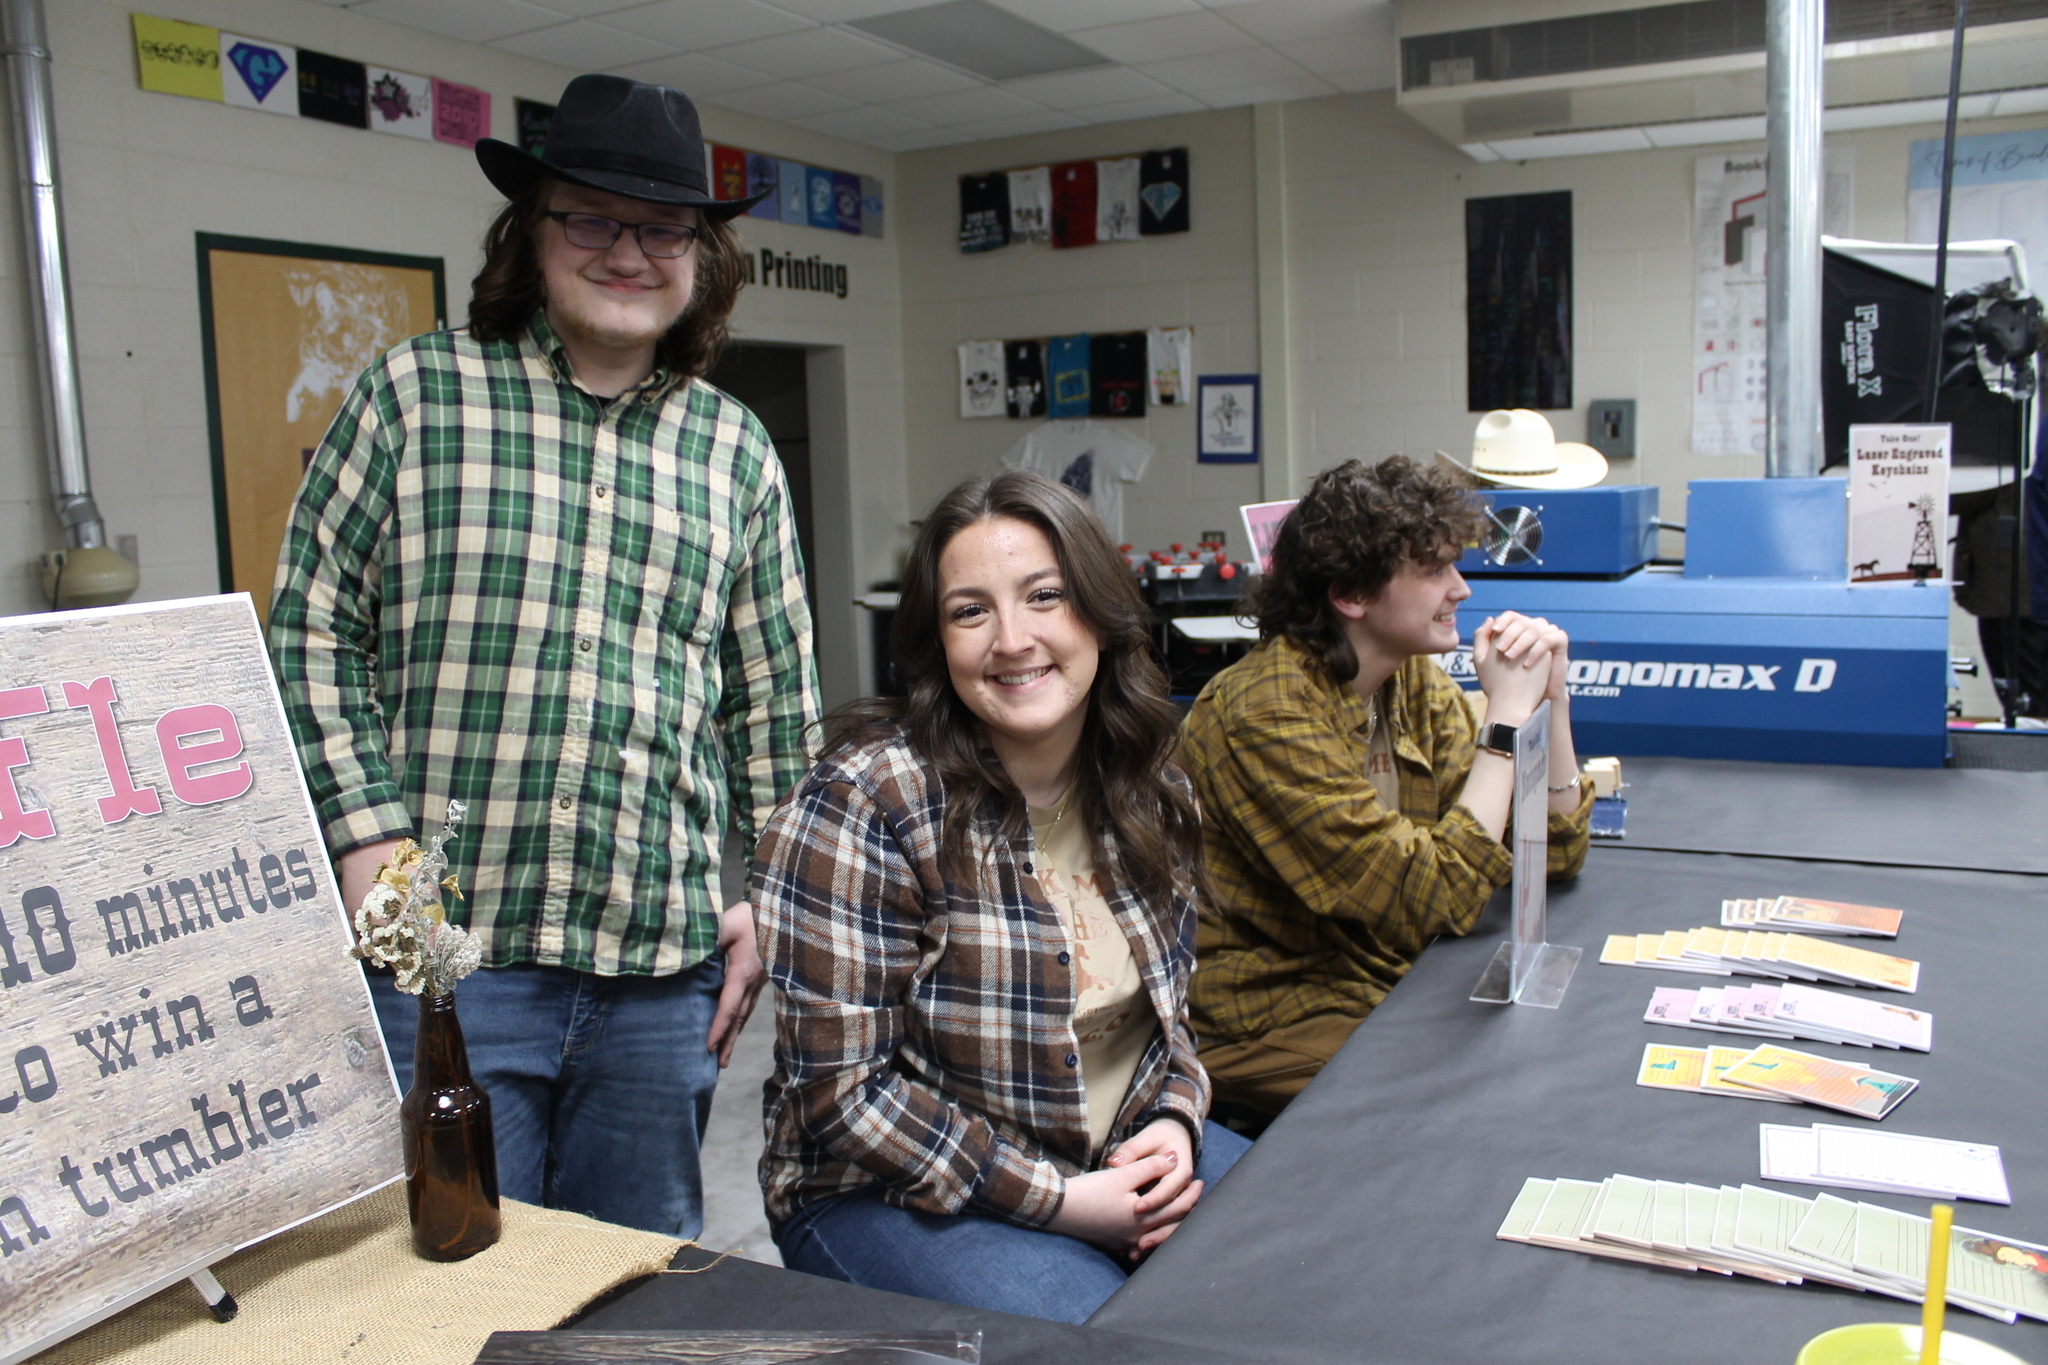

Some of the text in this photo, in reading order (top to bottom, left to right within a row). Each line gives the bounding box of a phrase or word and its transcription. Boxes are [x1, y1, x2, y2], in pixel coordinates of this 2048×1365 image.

[761, 247, 848, 298] Printing
[1855, 303, 1882, 398] Flora X
[1857, 448, 1943, 461] Laser Engraved
[1872, 464, 1929, 477] Keychains
[1568, 659, 1837, 693] onomax D
[0, 847, 317, 988] 10 minutes
[74, 987, 216, 1078] win
[228, 974, 273, 1027] a
[58, 1072, 321, 1218] tumbler
